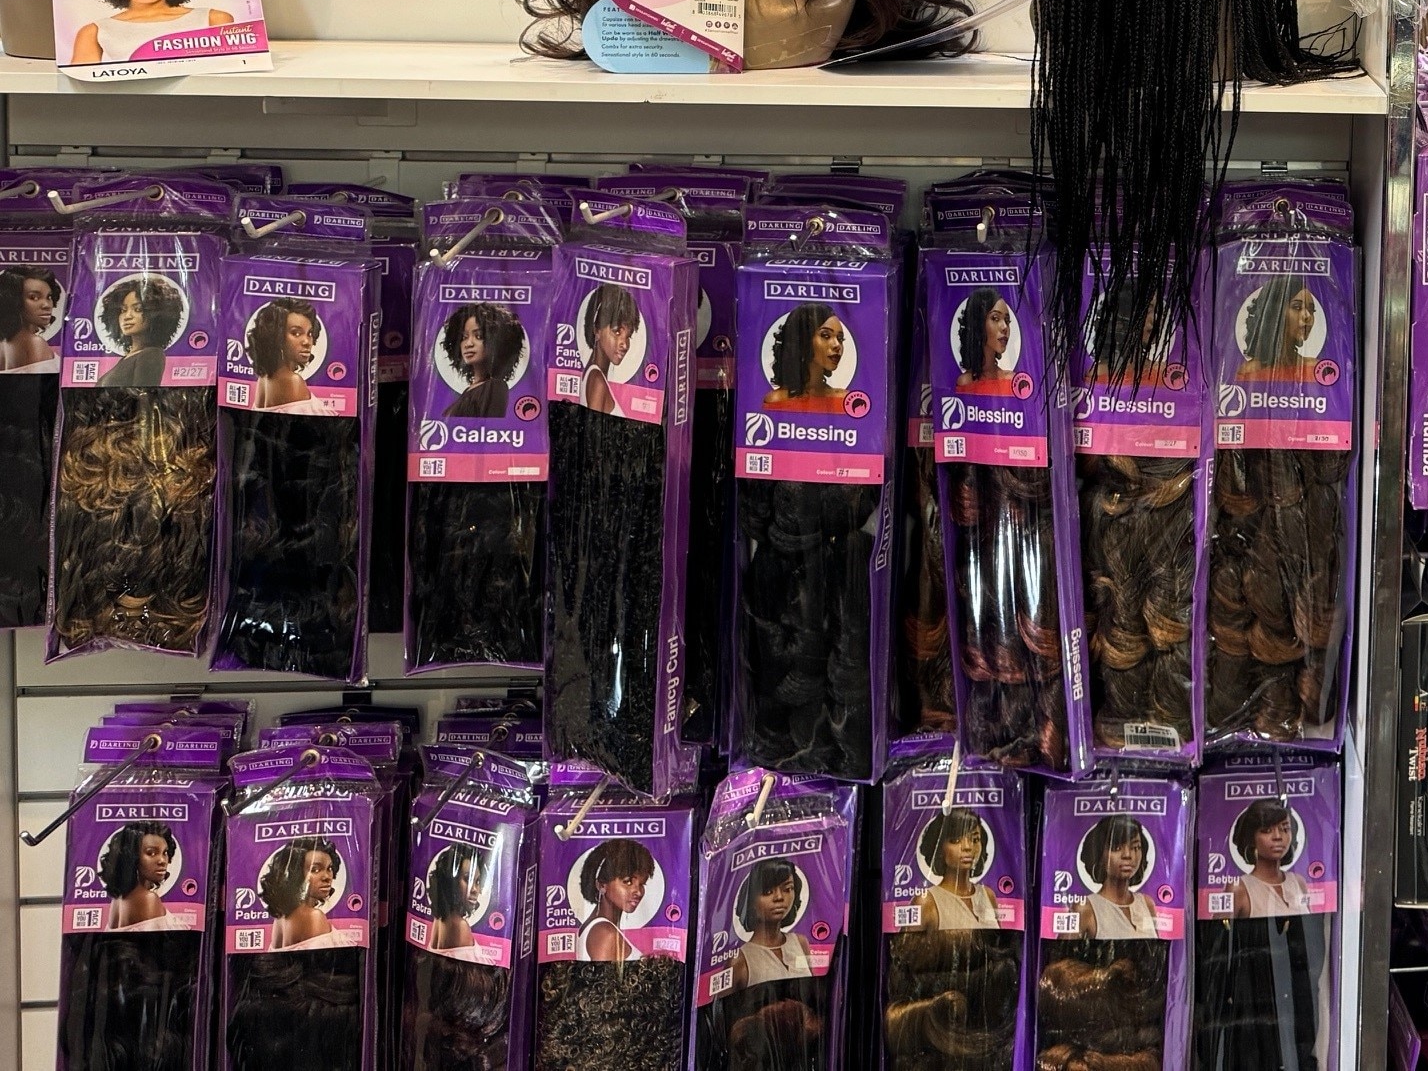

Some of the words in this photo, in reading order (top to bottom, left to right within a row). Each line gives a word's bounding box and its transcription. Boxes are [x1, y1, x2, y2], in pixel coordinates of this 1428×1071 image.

[219, 25, 253, 35] Instant
[154, 36, 222, 52] FASHION
[225, 33, 257, 45] WIG
[92, 67, 148, 78] LATOYA
[326, 218, 362, 226] DARLING
[761, 222, 801, 230] DARLING
[839, 225, 879, 233] DARLING
[0, 250, 68, 262] ARLING
[102, 256, 194, 268] DARLING
[1247, 259, 1326, 271] DARLING
[580, 261, 648, 284] DARLING
[950, 269, 1016, 283] DARLING
[250, 280, 331, 298] DARLING
[446, 288, 527, 301] DARLING
[770, 284, 855, 300] DARLING
[556, 346, 580, 358] Fanc
[226, 361, 254, 376] Patra
[555, 356, 583, 369] Curls
[676, 331, 688, 421] DARLING
[1099, 396, 1176, 418] Blessing
[1250, 392, 1328, 414] Blessing
[967, 405, 1024, 429] Blessing
[452, 425, 525, 447] Galaxy
[777, 422, 858, 447] Blessing
[666, 635, 679, 674] Curl
[1070, 627, 1082, 701] Blessing
[663, 677, 680, 735] Fancy
[101, 741, 139, 749] DARLING
[178, 742, 216, 750] DARLING
[250, 759, 292, 768] DARLING
[1408, 746, 1418, 782] Twist
[1231, 781, 1309, 796] DARLNG
[917, 791, 1000, 805] DALING
[102, 807, 183, 818] DARLING
[1080, 799, 1162, 812] DARLING
[261, 820, 347, 838] DARLING
[434, 822, 498, 847] DARLING
[575, 821, 660, 834] DARLING
[736, 839, 816, 865] DARLING
[1208, 875, 1240, 886] Betty
[74, 889, 107, 899] Patra
[894, 885, 928, 899] Betty
[1054, 894, 1087, 905] Betty
[235, 910, 268, 920] Patra
[411, 901, 432, 915] Patra
[523, 870, 535, 956] DARLING
[546, 907, 574, 917] Fanc
[546, 917, 576, 927] Curls
[710, 947, 740, 966] Betty
